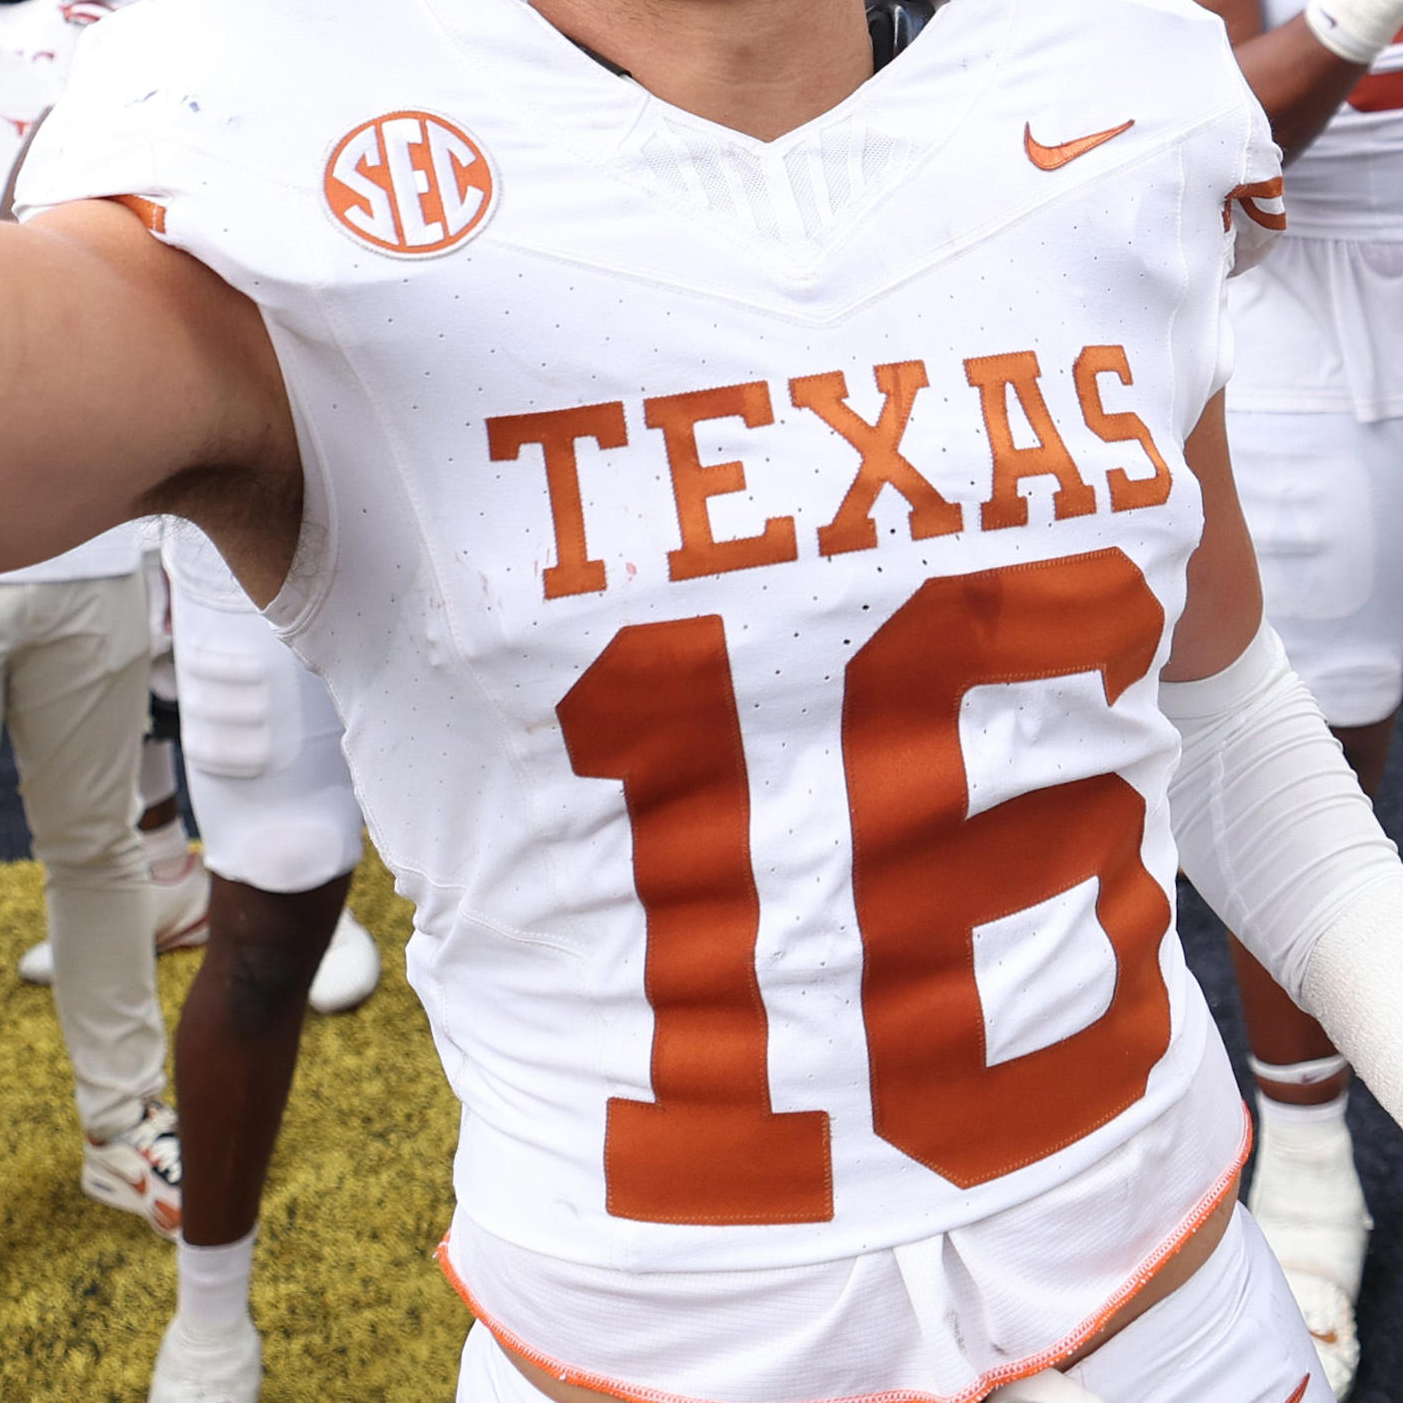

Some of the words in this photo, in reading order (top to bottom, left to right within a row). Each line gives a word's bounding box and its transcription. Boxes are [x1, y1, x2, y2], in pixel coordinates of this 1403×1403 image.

[332, 116, 486, 246] SEC
[485, 344, 1173, 600] TEXAS
[555, 546, 1172, 1226] 16
